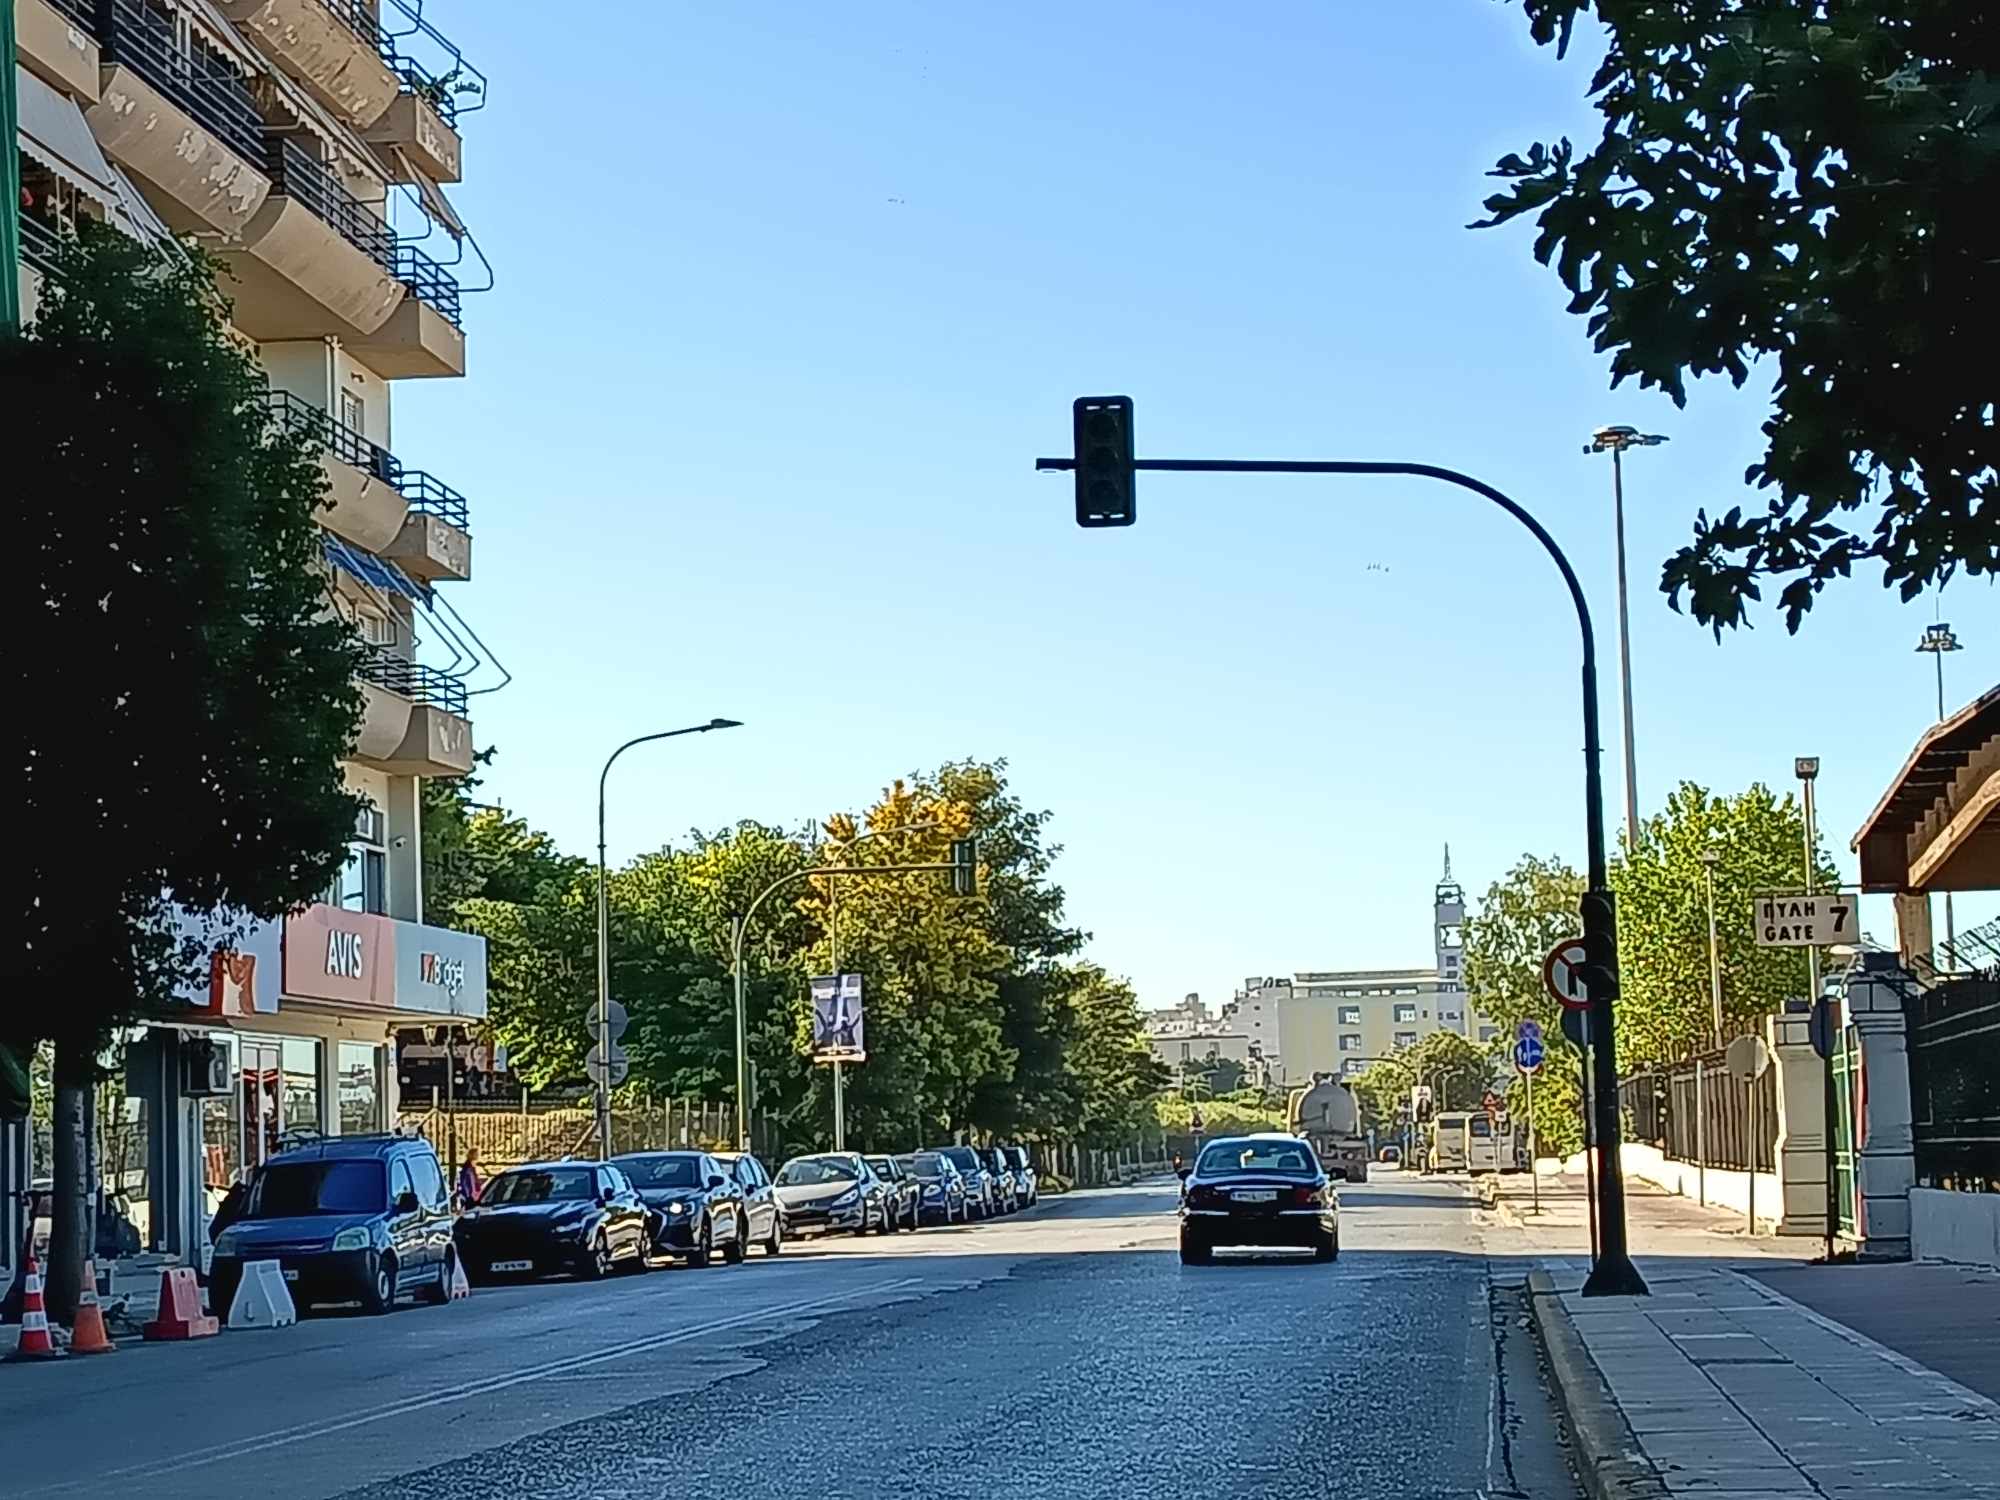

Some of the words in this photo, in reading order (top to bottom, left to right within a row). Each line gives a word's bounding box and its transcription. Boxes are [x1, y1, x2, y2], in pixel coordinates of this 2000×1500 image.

[1763, 901, 1816, 921] ΠΥΛΗ
[1829, 906, 1849, 933] 7
[1764, 924, 1815, 942] GATE
[325, 928, 363, 979] AVIS
[433, 952, 465, 997] Bdget
